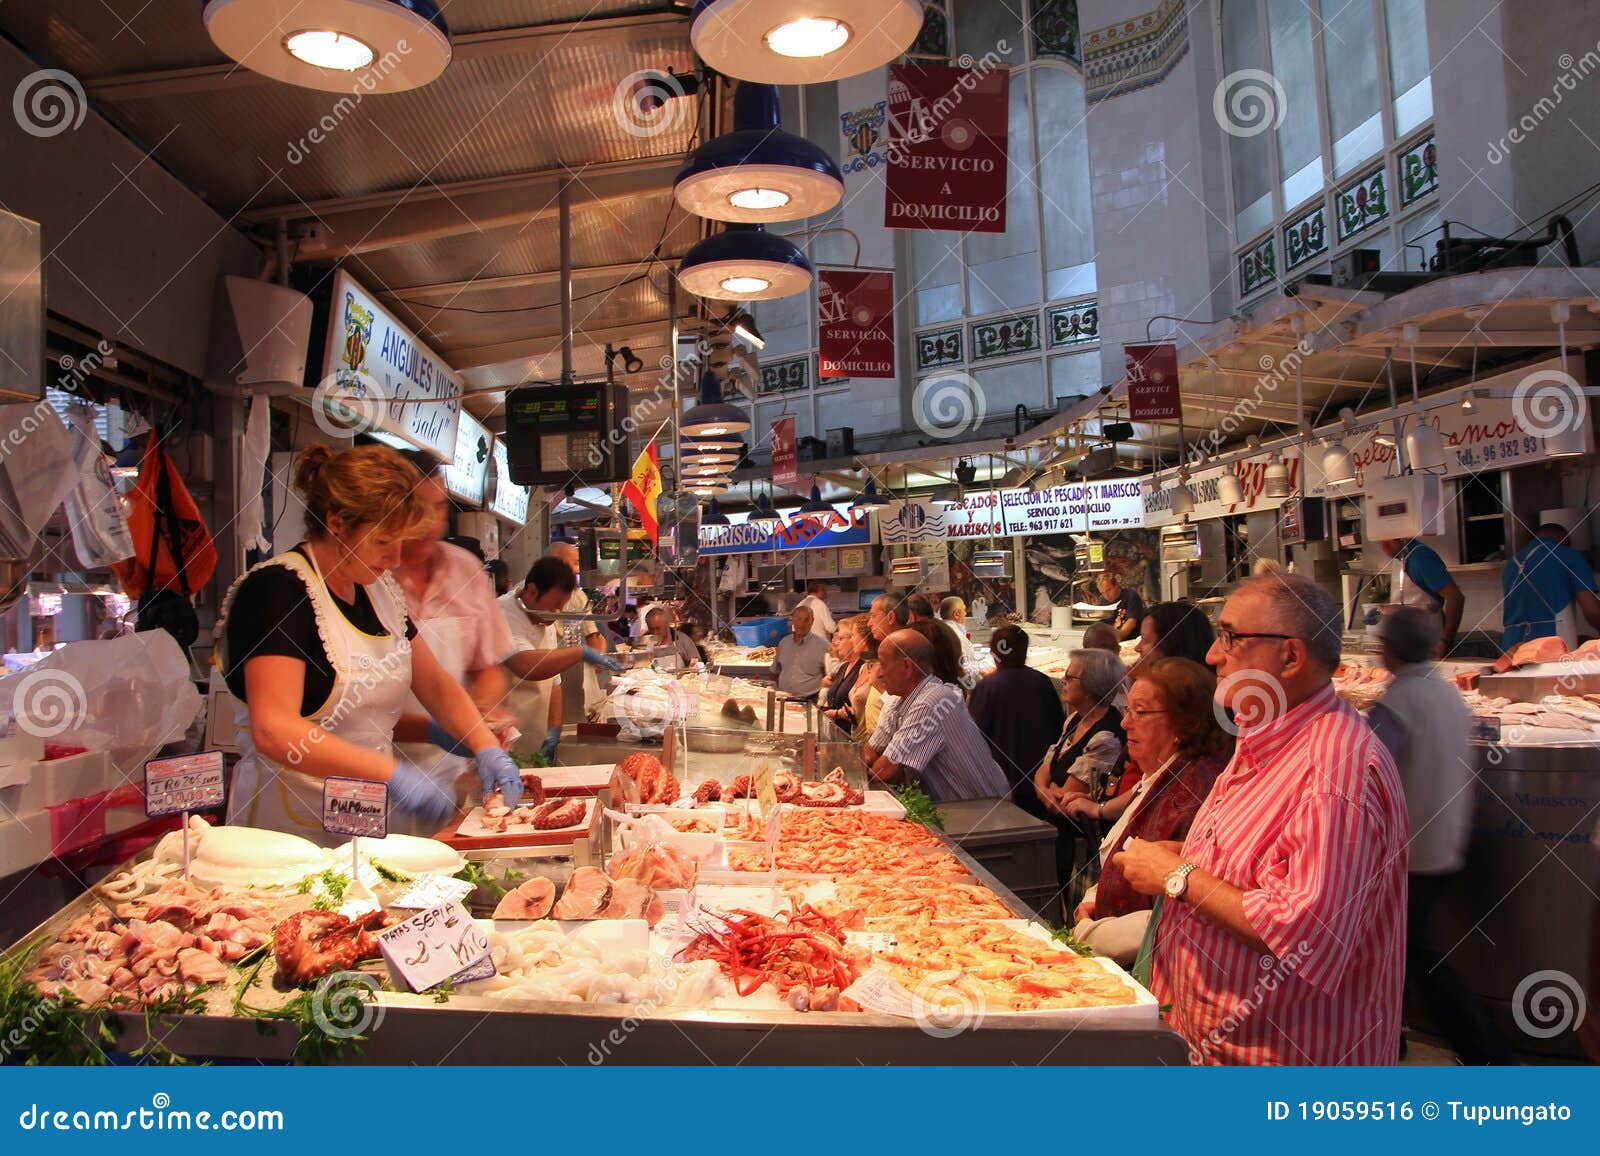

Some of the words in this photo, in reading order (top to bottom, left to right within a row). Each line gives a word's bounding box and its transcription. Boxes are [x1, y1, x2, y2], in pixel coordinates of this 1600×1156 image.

[900, 155, 995, 173] SERVICIO
[940, 181, 952, 195] A
[891, 202, 1000, 222] DOMICILIO
[826, 329, 887, 341] SERVICIO
[853, 346, 861, 356] A
[381, 325, 433, 393] ANGUILES
[435, 368, 459, 414] VIVES
[823, 360, 891, 372] DOMICILIO
[1135, 385, 1170, 394] SERVICI
[1483, 445, 1496, 462] 96
[1500, 439, 1520, 457] 382
[1523, 435, 1537, 453] 93
[1043, 488, 1053, 504] DE
[1094, 483, 1099, 499] Y
[1101, 481, 1141, 499] MARISCOS
[967, 510, 975, 523] Y
[1027, 506, 1060, 519] SERVICIO
[1062, 505, 1068, 515] A
[1069, 502, 1111, 515] DOMICILIO
[699, 520, 769, 548] MARISCOS
[771, 508, 867, 545] ARNAU
[947, 520, 1002, 538] MARISCOS
[1029, 520, 1043, 531] 963
[1045, 519, 1058, 530] 917
[1060, 518, 1073, 529] 621
[382, 923, 410, 944] PATAS
[411, 902, 455, 932] SEPIA
